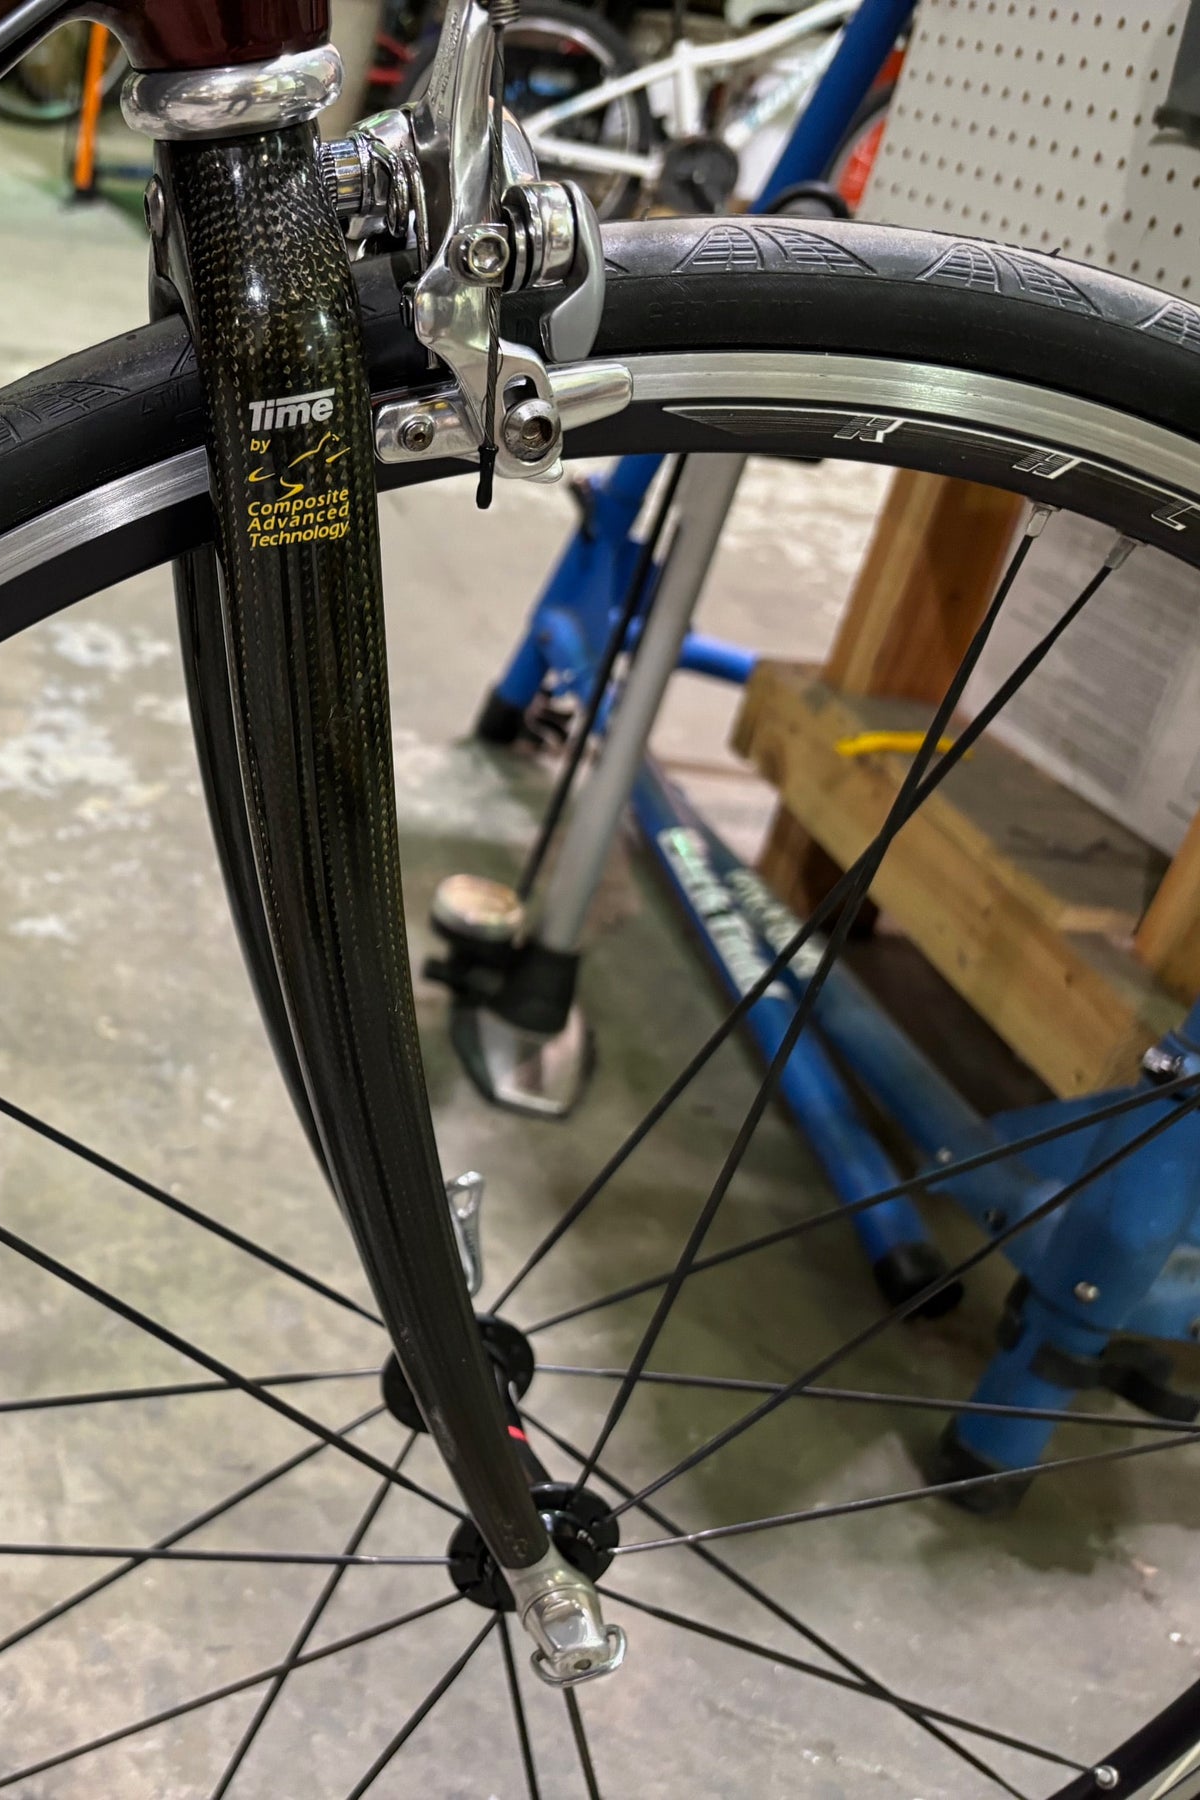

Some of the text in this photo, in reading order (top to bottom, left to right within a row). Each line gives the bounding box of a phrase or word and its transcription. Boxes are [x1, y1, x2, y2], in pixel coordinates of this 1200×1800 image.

[249, 388, 335, 431] Time
[250, 438, 271, 454] by
[247, 489, 349, 516] Composite
[247, 501, 350, 532] Advanced
[249, 521, 350, 548] Technology
